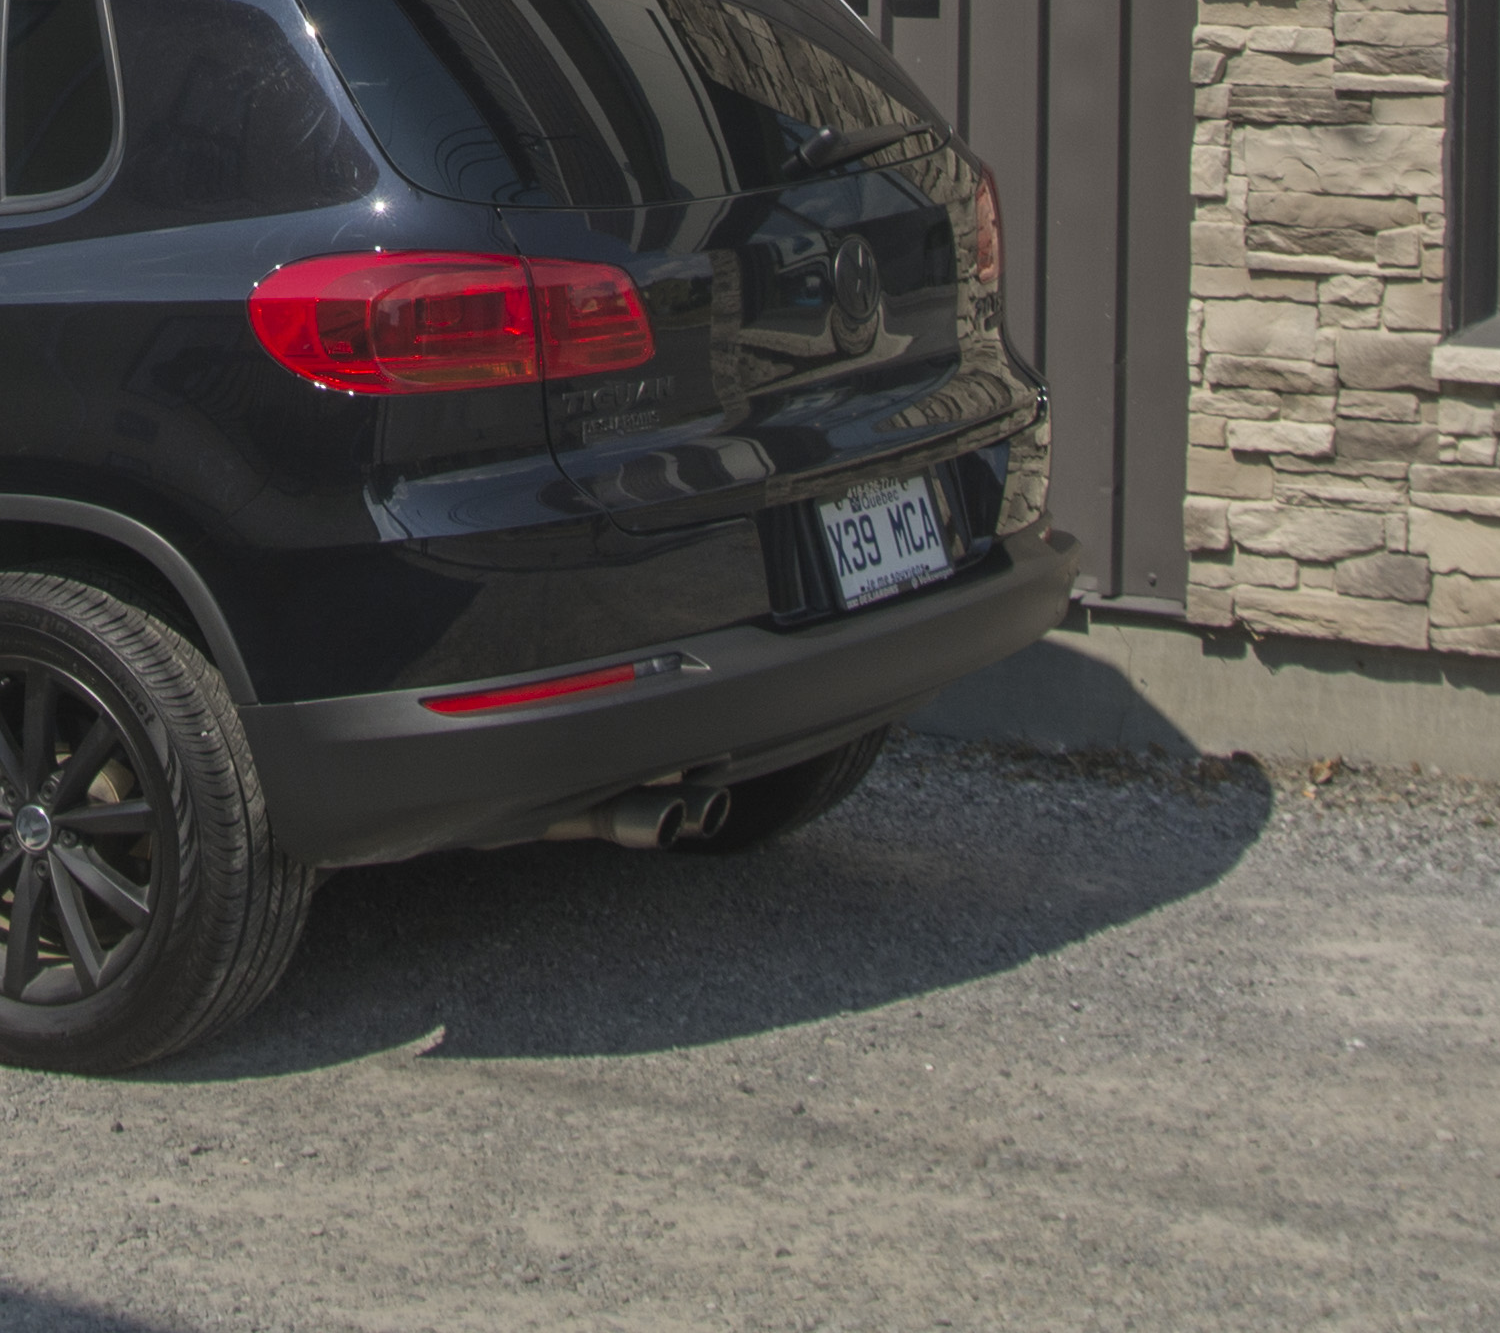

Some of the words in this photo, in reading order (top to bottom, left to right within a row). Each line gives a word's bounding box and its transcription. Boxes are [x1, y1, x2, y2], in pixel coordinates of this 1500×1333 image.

[561, 376, 676, 414] TIGUAN
[827, 514, 882, 577] X39
[887, 497, 940, 558] MCA
